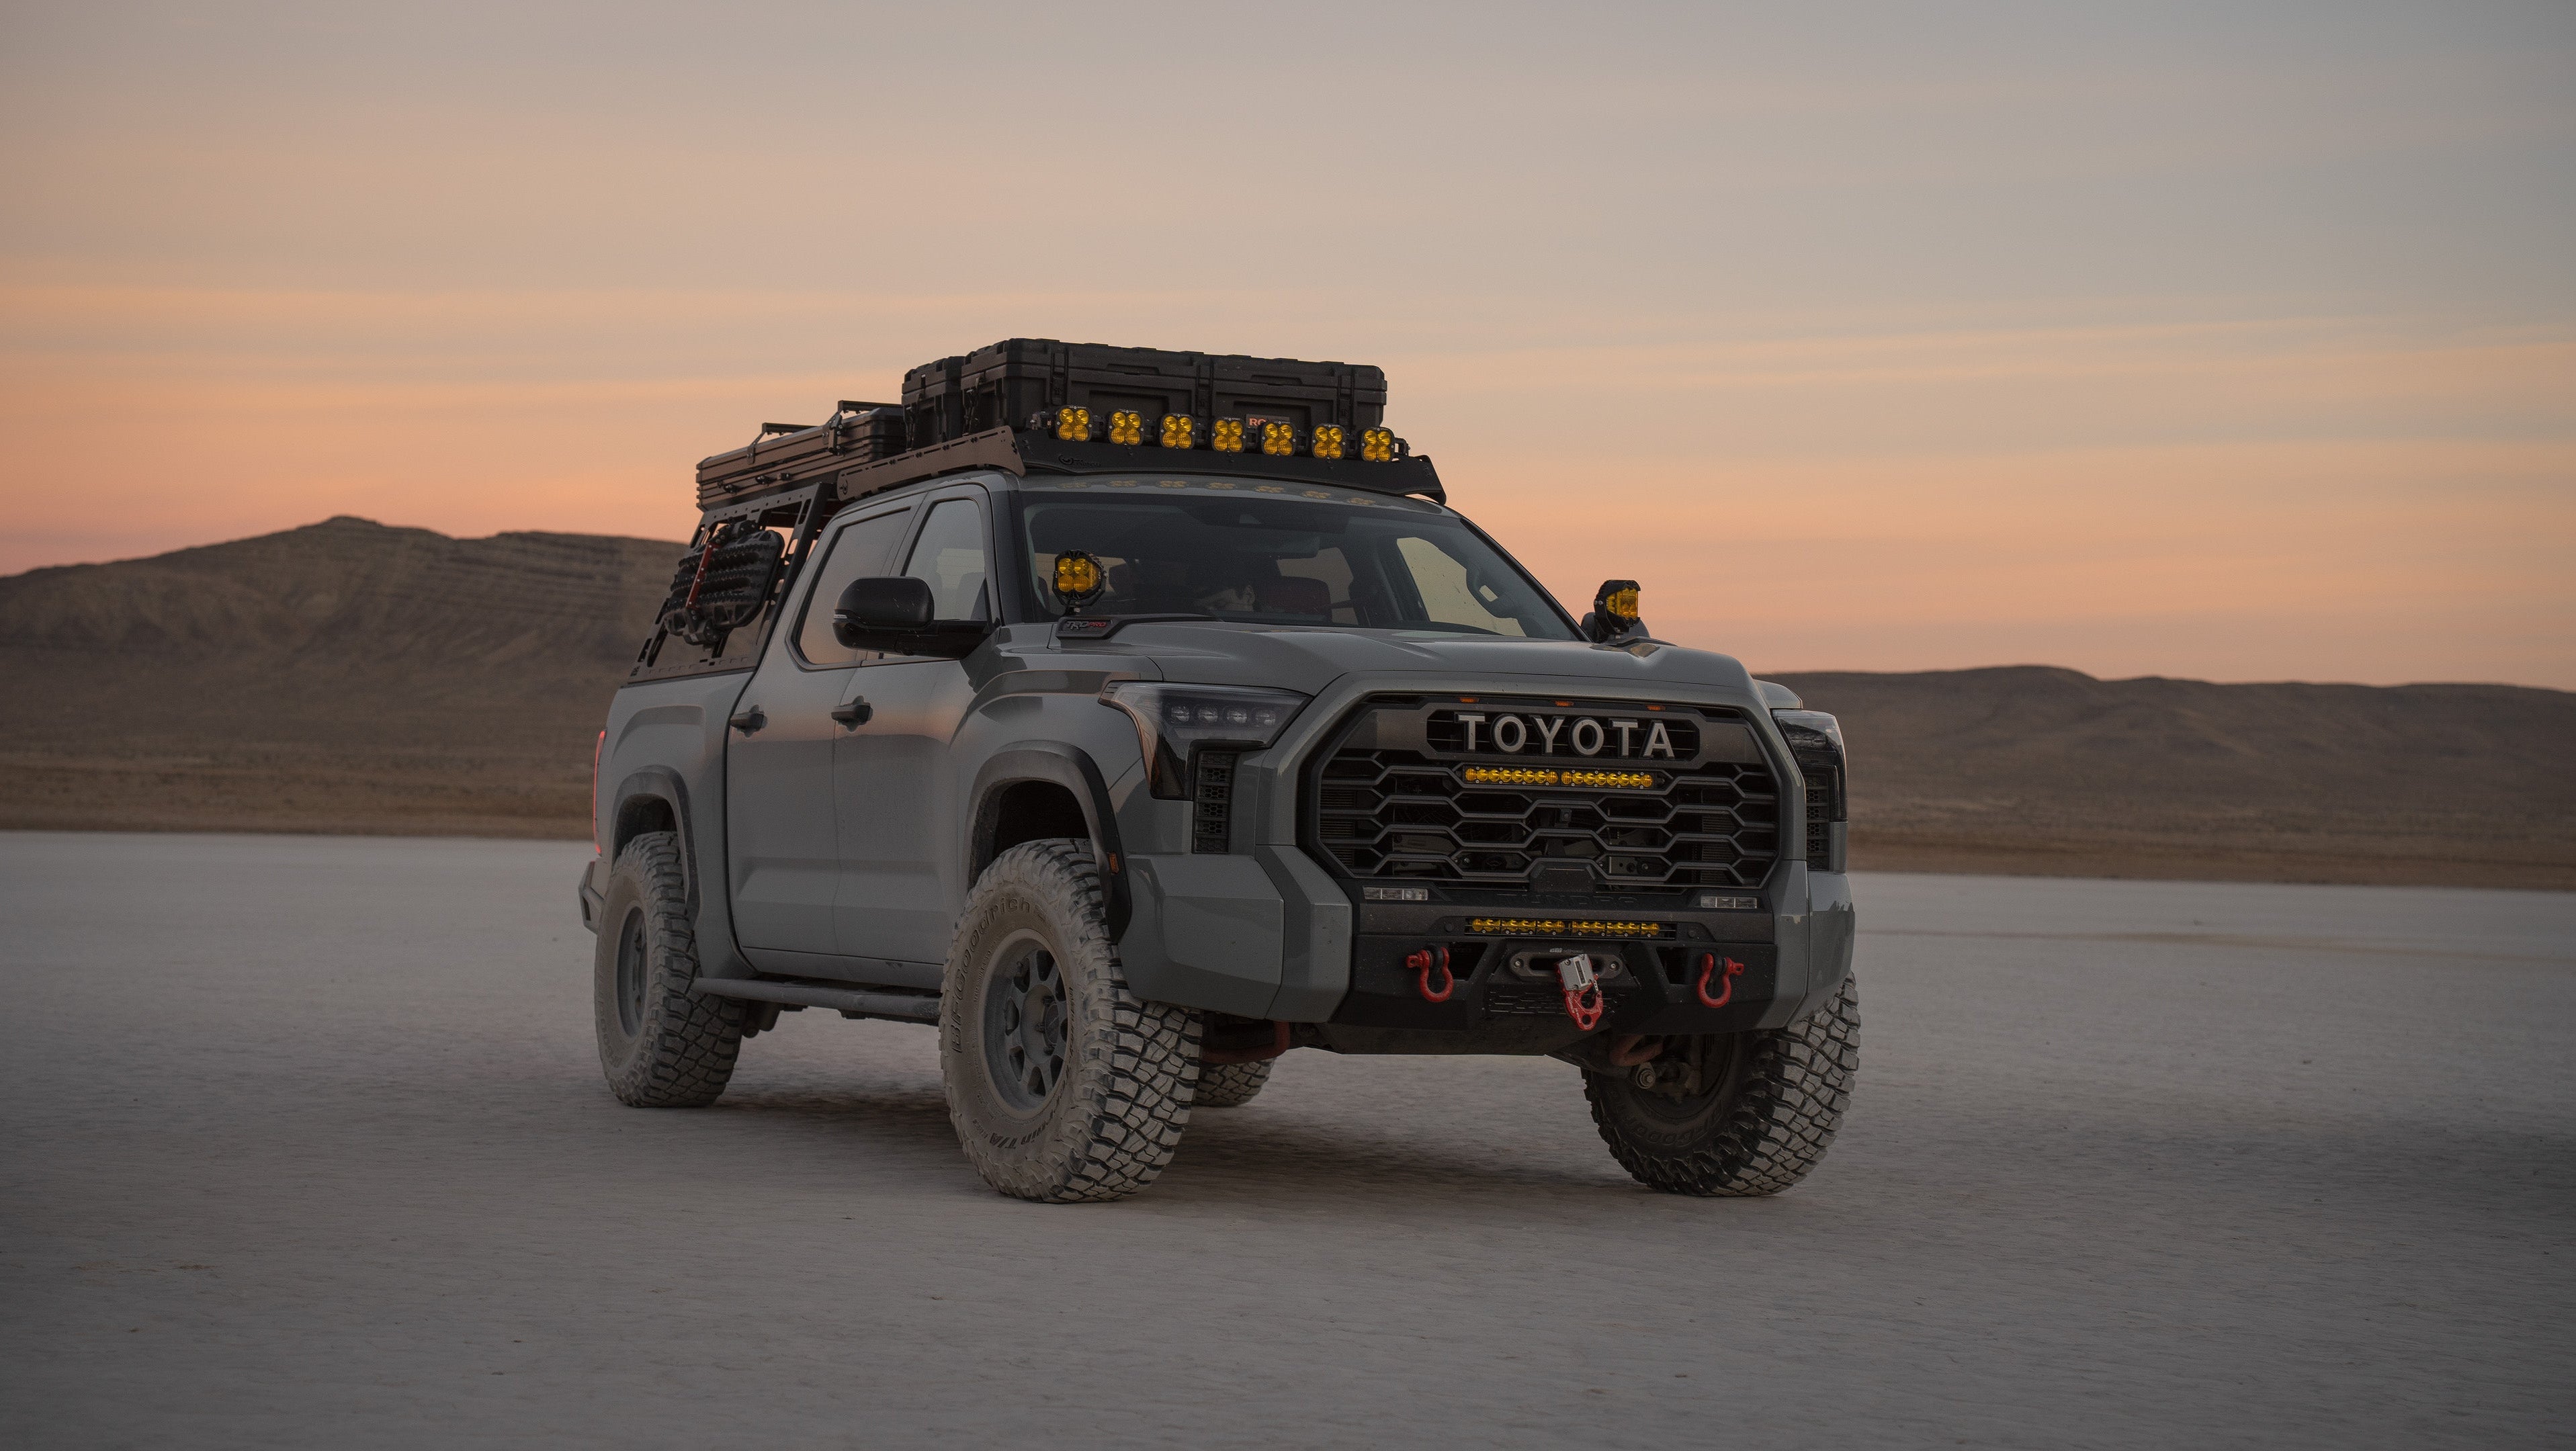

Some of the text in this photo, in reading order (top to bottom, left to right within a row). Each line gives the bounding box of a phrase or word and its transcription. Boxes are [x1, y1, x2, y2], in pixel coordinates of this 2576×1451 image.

[1066, 621, 1088, 630] TRD
[1456, 713, 1675, 758] TOYOTA
[951, 897, 1031, 1053] BFGoodrich
